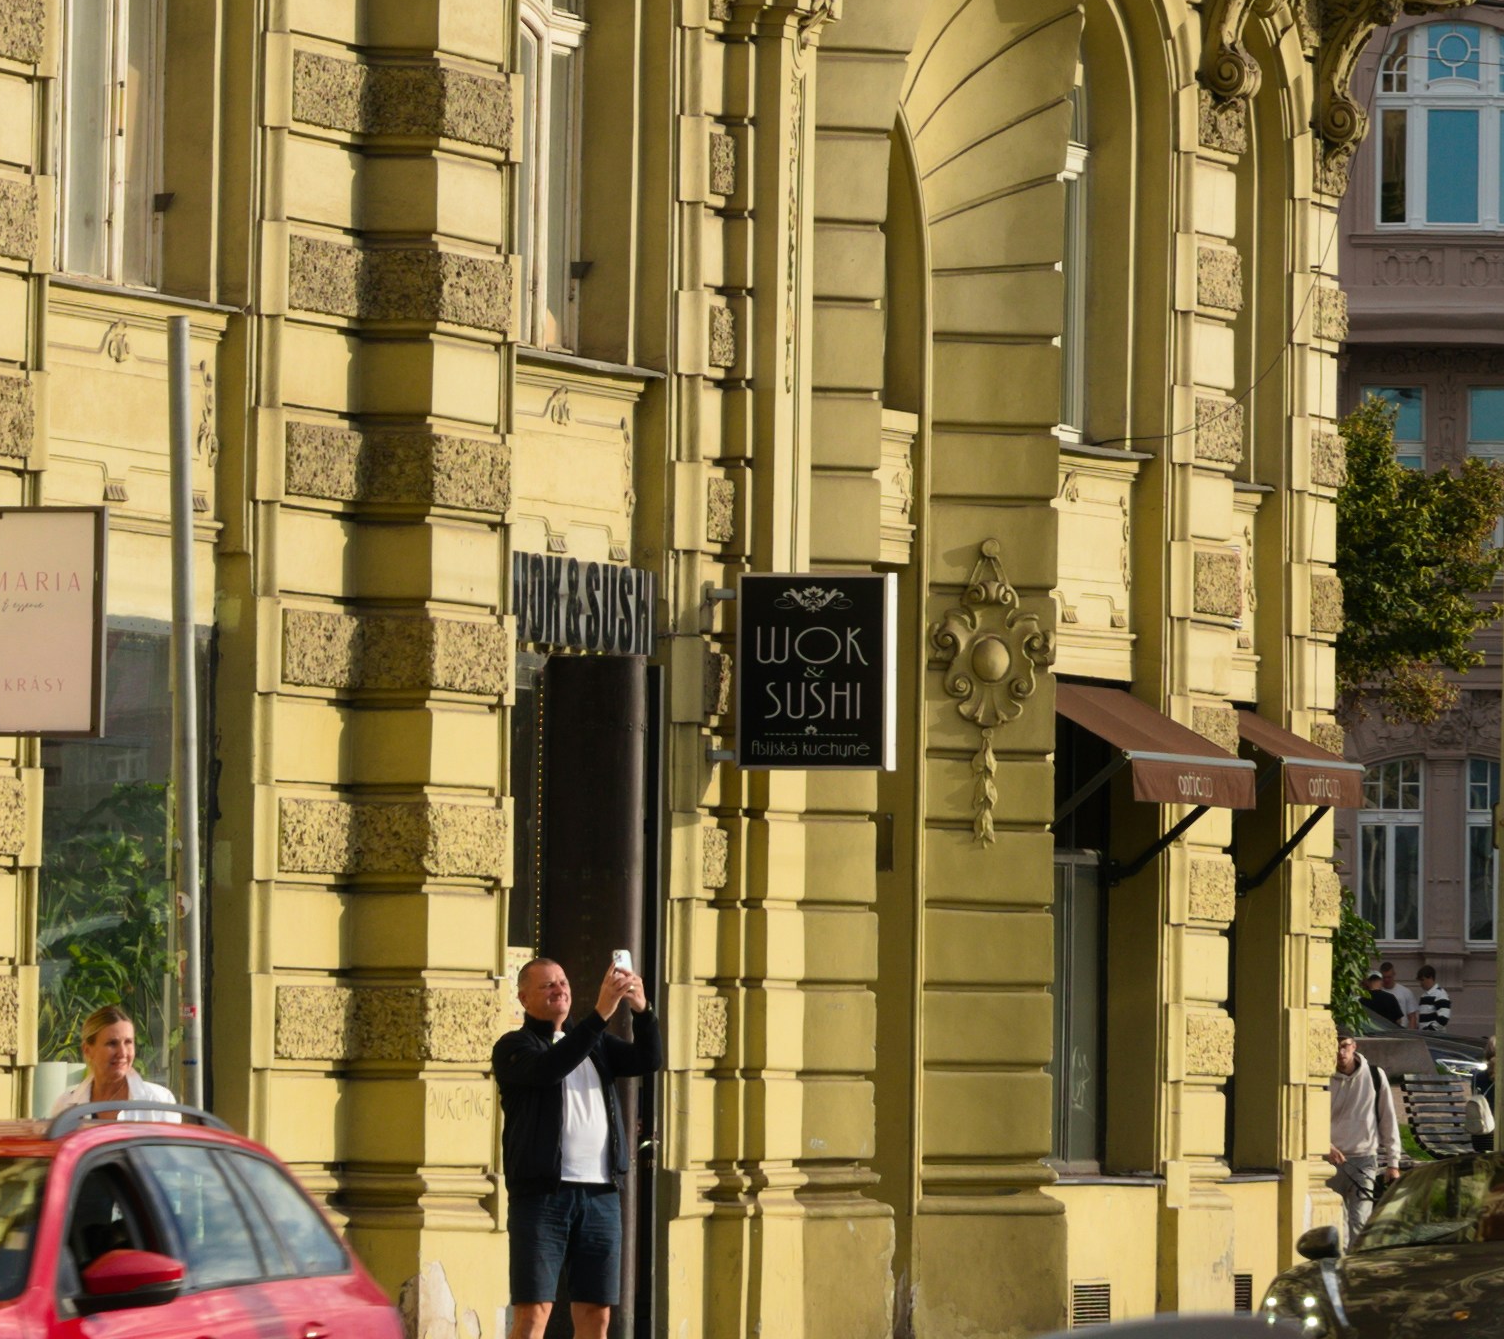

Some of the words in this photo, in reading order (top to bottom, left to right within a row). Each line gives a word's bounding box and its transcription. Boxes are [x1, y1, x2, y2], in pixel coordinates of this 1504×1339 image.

[756, 626, 869, 666] WOK
[803, 665, 828, 678] &
[4, 674, 65, 692] KRÁSY
[764, 682, 861, 720] SUSHI
[751, 739, 798, 757] Asijská
[802, 740, 871, 758] kuchyně
